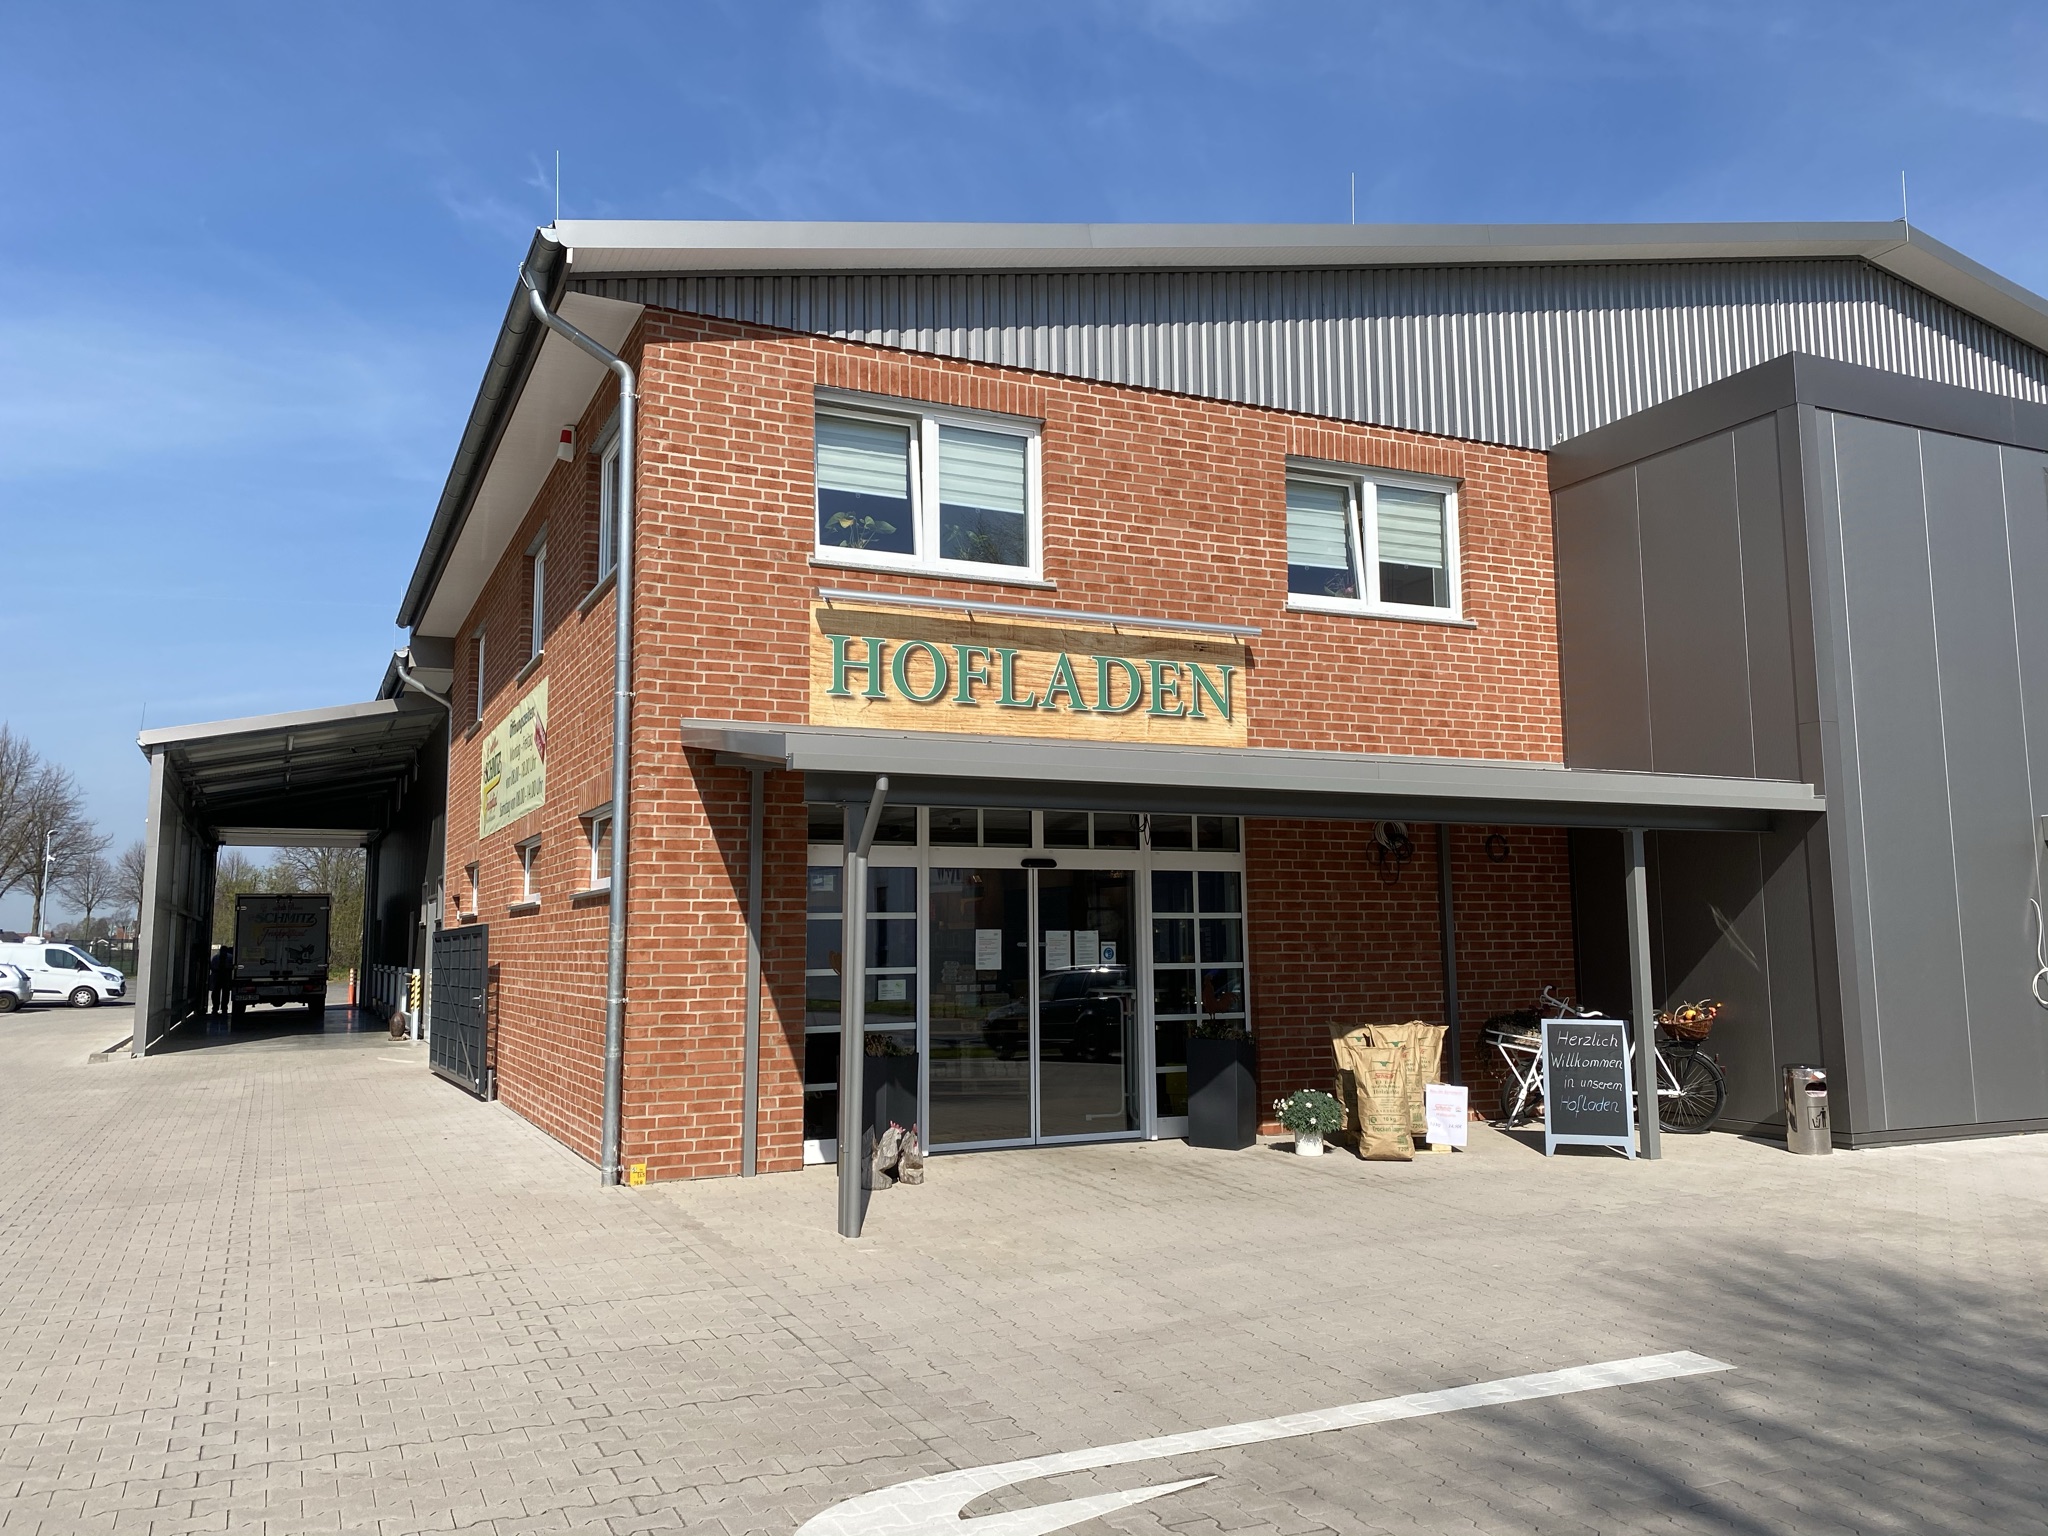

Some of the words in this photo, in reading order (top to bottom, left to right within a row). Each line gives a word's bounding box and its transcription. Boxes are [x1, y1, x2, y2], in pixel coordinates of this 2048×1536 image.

[825, 634, 1234, 720] HOFLADEN
[255, 912, 317, 925] SCHMITZ
[1557, 1030, 1618, 1047] Herzlich
[1550, 1051, 1623, 1069] Willkommen
[1563, 1075, 1574, 1088] in
[1580, 1079, 1623, 1091] unserem
[1560, 1095, 1620, 1118] Hofladen
